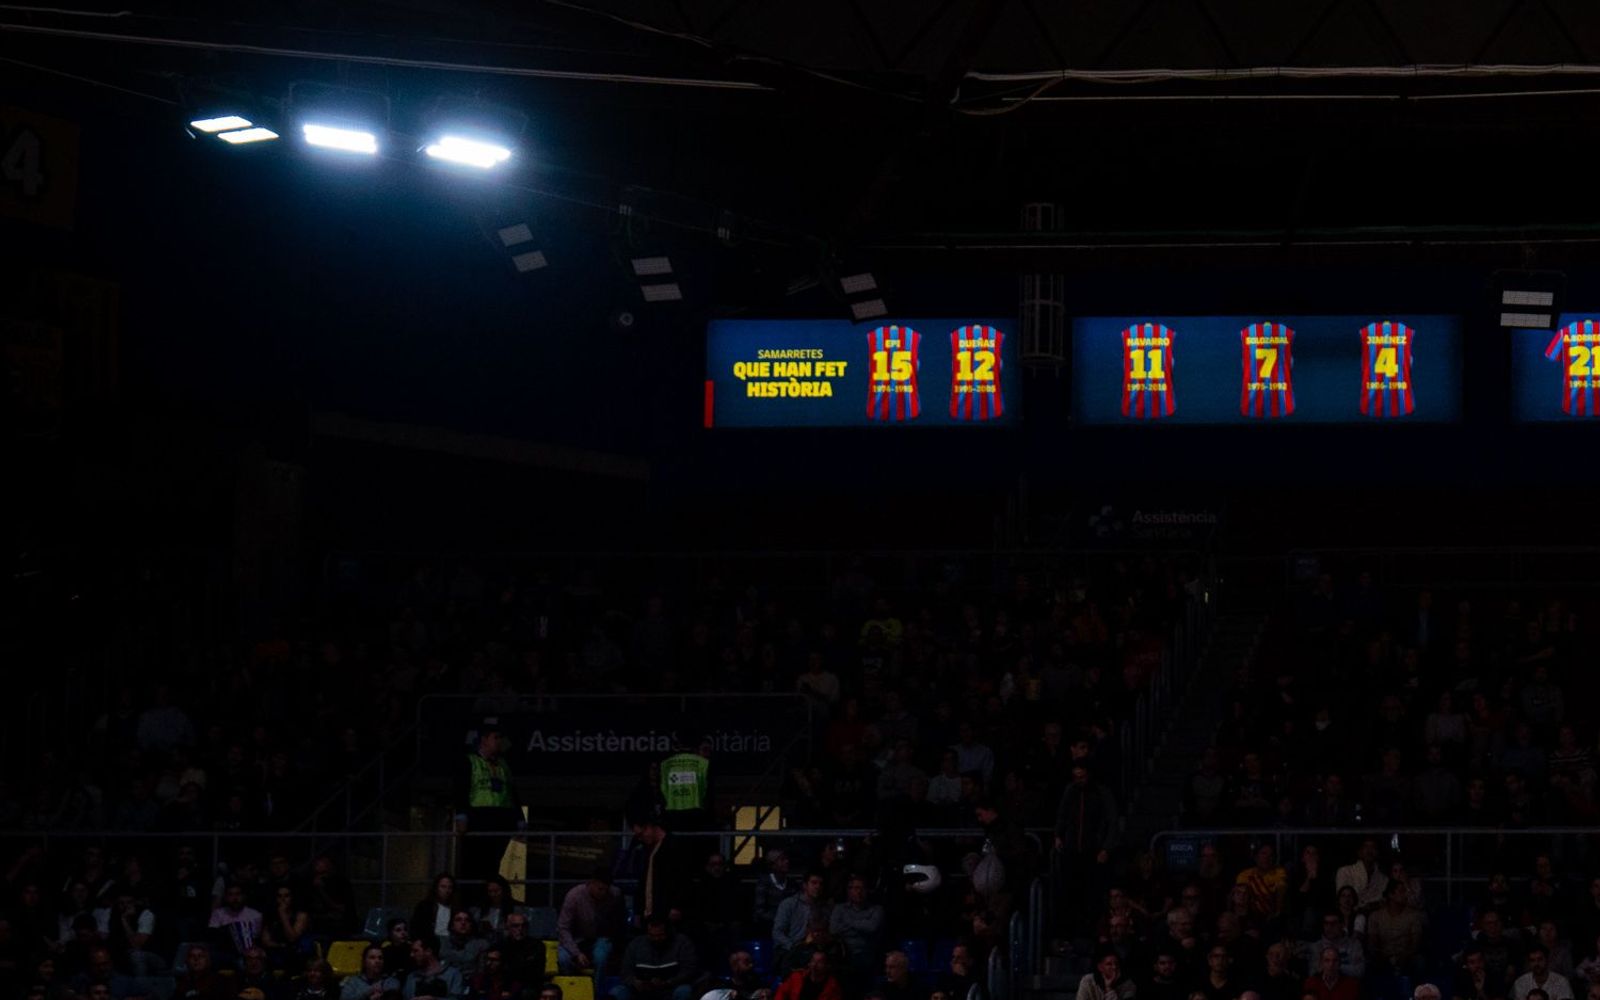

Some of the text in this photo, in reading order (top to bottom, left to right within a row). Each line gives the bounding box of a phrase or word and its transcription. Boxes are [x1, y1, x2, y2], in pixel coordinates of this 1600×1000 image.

[885, 339, 901, 348] EPI
[958, 337, 996, 348] DUEÑAS
[1126, 337, 1170, 347] NAVARRO
[1366, 334, 1407, 344] JIMÉNEZ
[757, 349, 824, 360] SAMARRETES
[1129, 349, 1165, 379] 11
[1255, 348, 1278, 378] 7
[1374, 347, 1399, 377] 4
[733, 361, 848, 381] QUE HAN FET
[873, 351, 913, 381] 15
[956, 351, 996, 381] 12
[746, 377, 833, 397] HISTÒRIA
